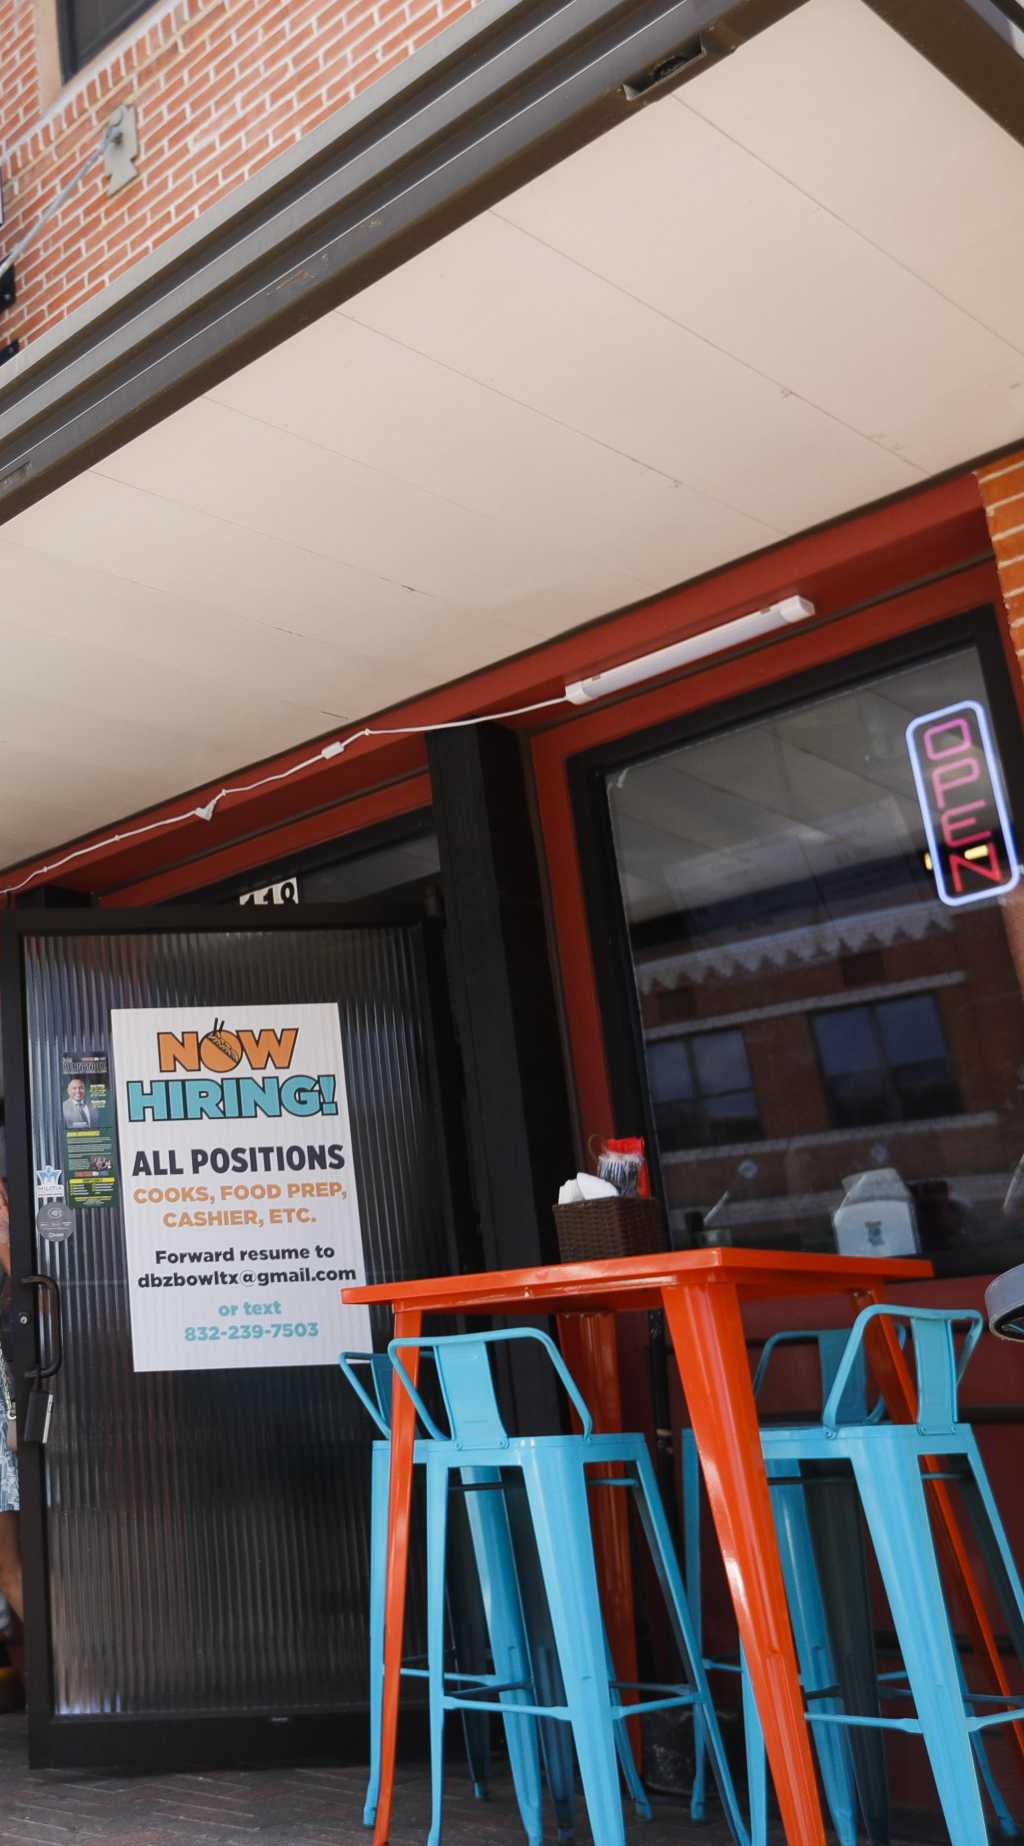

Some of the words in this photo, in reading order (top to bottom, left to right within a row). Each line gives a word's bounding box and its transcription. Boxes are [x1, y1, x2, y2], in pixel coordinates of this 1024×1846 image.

[924, 718, 1002, 892] OPEN
[157, 1027, 299, 1073] NOW
[127, 1074, 338, 1122] HIRING!
[132, 1150, 184, 1177] ALL
[192, 1144, 345, 1175] POSITIONS
[133, 1186, 216, 1206] COOKS,
[220, 1183, 282, 1201] FOOD
[287, 1182, 348, 1200] PREP,
[163, 1209, 265, 1228] CASHIER,
[269, 1208, 317, 1224] ETC.
[155, 1247, 236, 1265] Forward
[239, 1247, 310, 1262] resume
[315, 1244, 335, 1259] to
[137, 1267, 357, 1289] dbzbowltx@gmail.com
[218, 1303, 240, 1317] or
[243, 1300, 282, 1316] text
[185, 1322, 319, 1342] 832-239-7503
